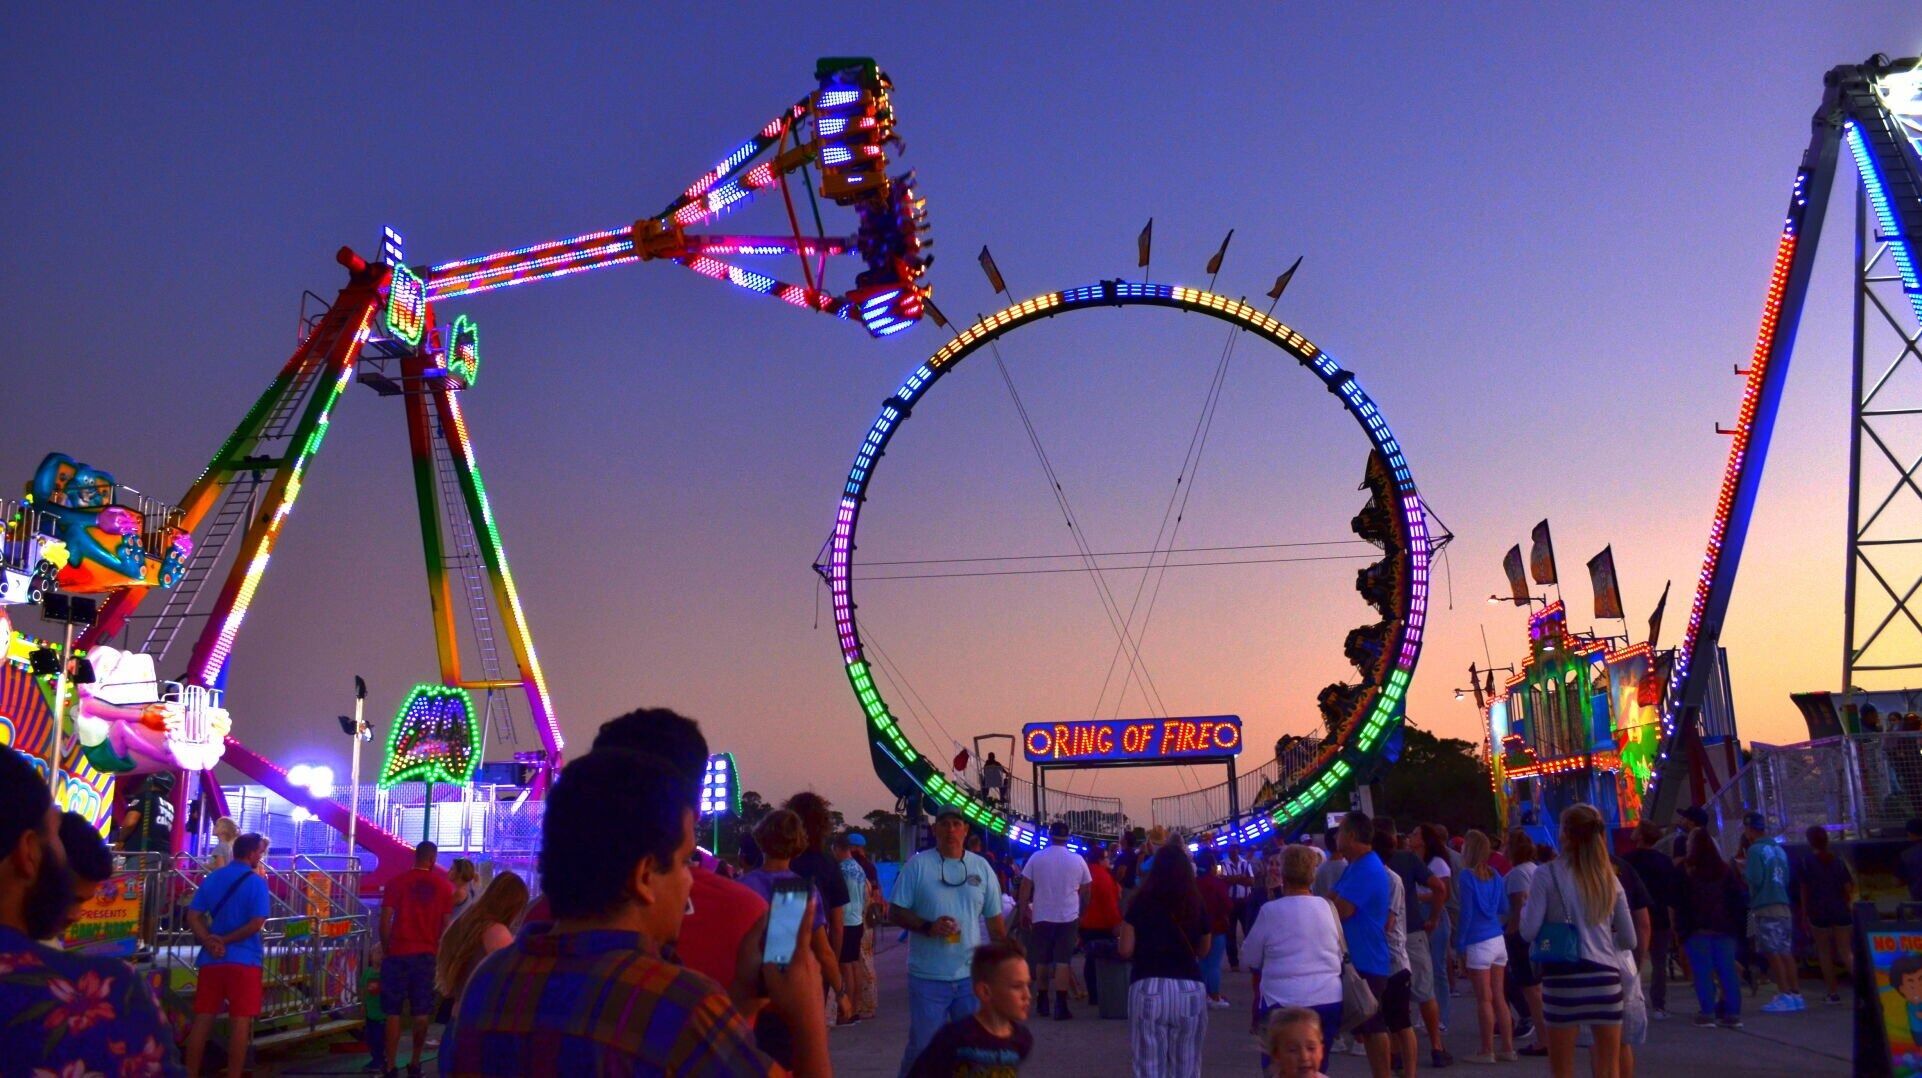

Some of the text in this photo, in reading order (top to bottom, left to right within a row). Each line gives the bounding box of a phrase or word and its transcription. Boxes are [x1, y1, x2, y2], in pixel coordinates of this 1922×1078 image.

[1054, 719, 1214, 759] RING OF FIRE
[1872, 935, 1897, 952] NO
